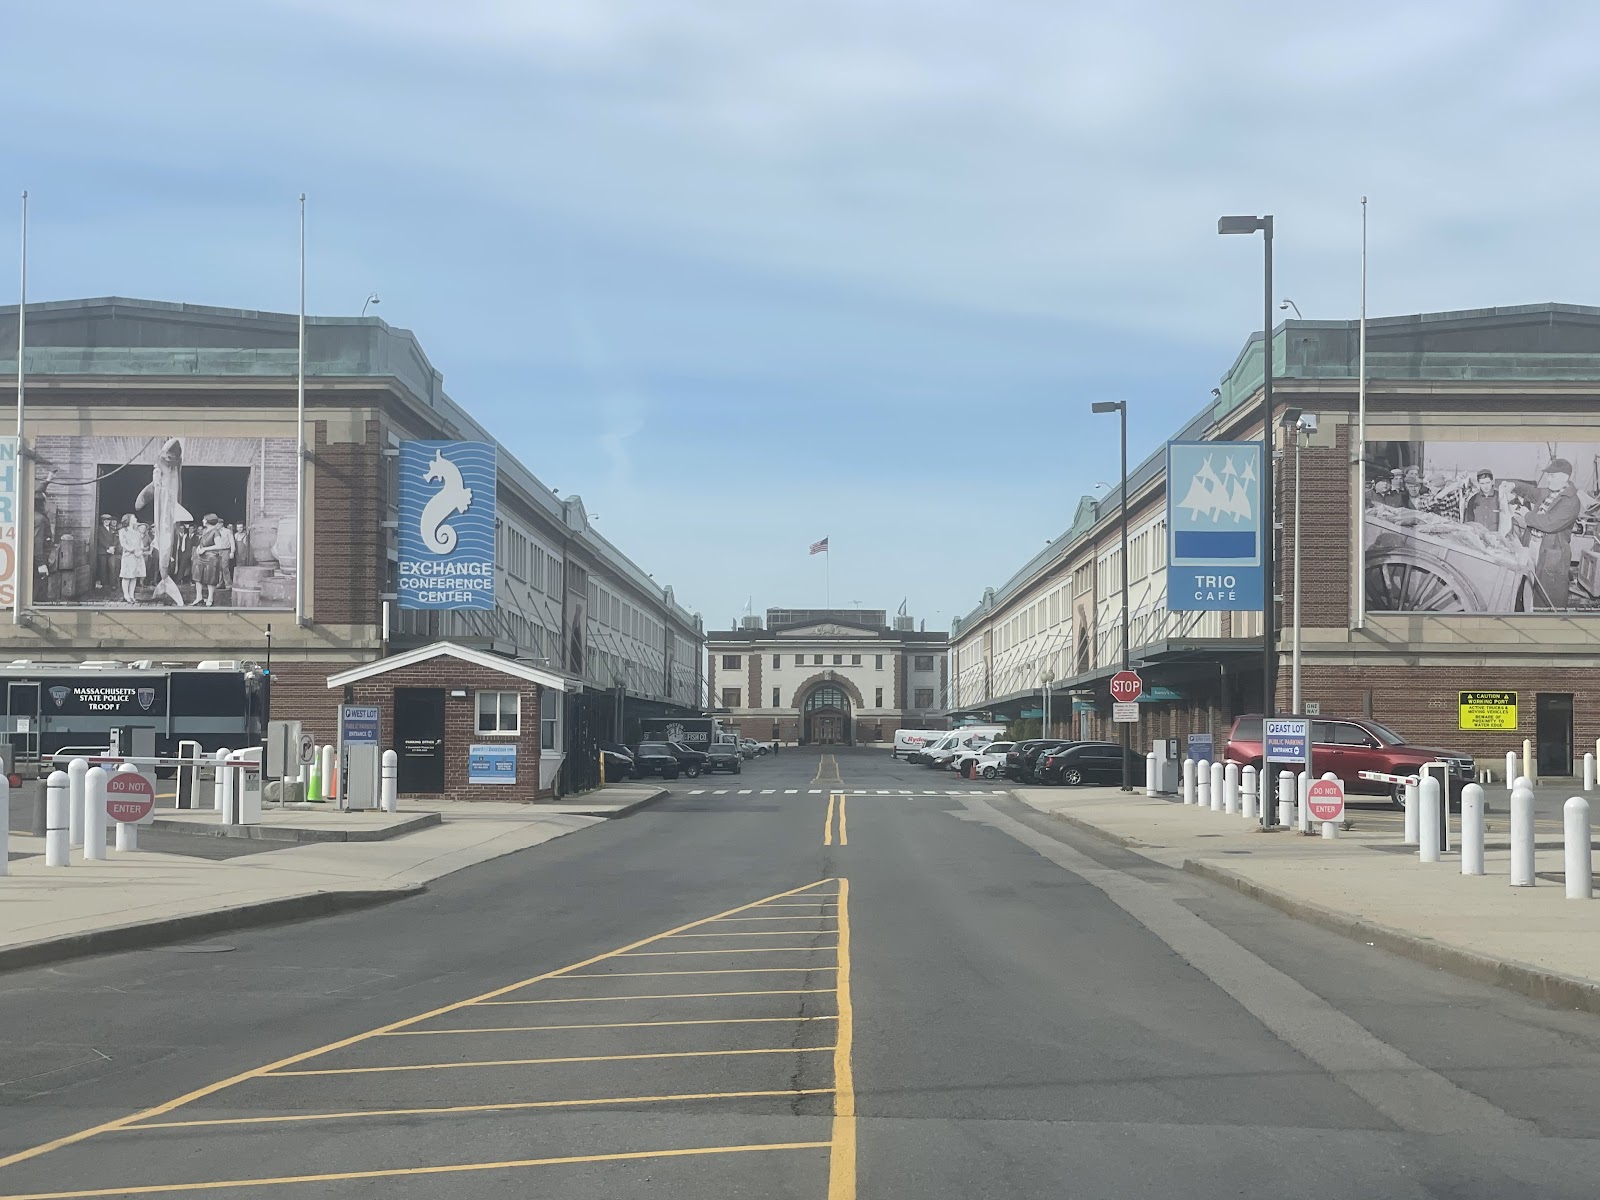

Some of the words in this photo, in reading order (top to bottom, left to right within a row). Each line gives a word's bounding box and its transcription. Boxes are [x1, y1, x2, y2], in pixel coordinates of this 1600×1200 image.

[399, 561, 492, 576] EXCHANGE
[399, 577, 492, 590] CONFERENCE
[1194, 575, 1236, 589] TRIO
[418, 591, 472, 602] CENTER
[1194, 590, 1236, 601] CAFÉ
[1112, 680, 1140, 692] STOP
[351, 709, 366, 718] WEST
[366, 709, 377, 718] LOT
[1275, 724, 1291, 733] EAST
[1292, 724, 1304, 733] LOT
[112, 781, 125, 791] DO
[128, 782, 146, 792] NOT
[1313, 787, 1323, 795] DO
[1324, 787, 1337, 795] NOT
[113, 804, 141, 813] ENTER
[1315, 805, 1336, 813] ENTER
